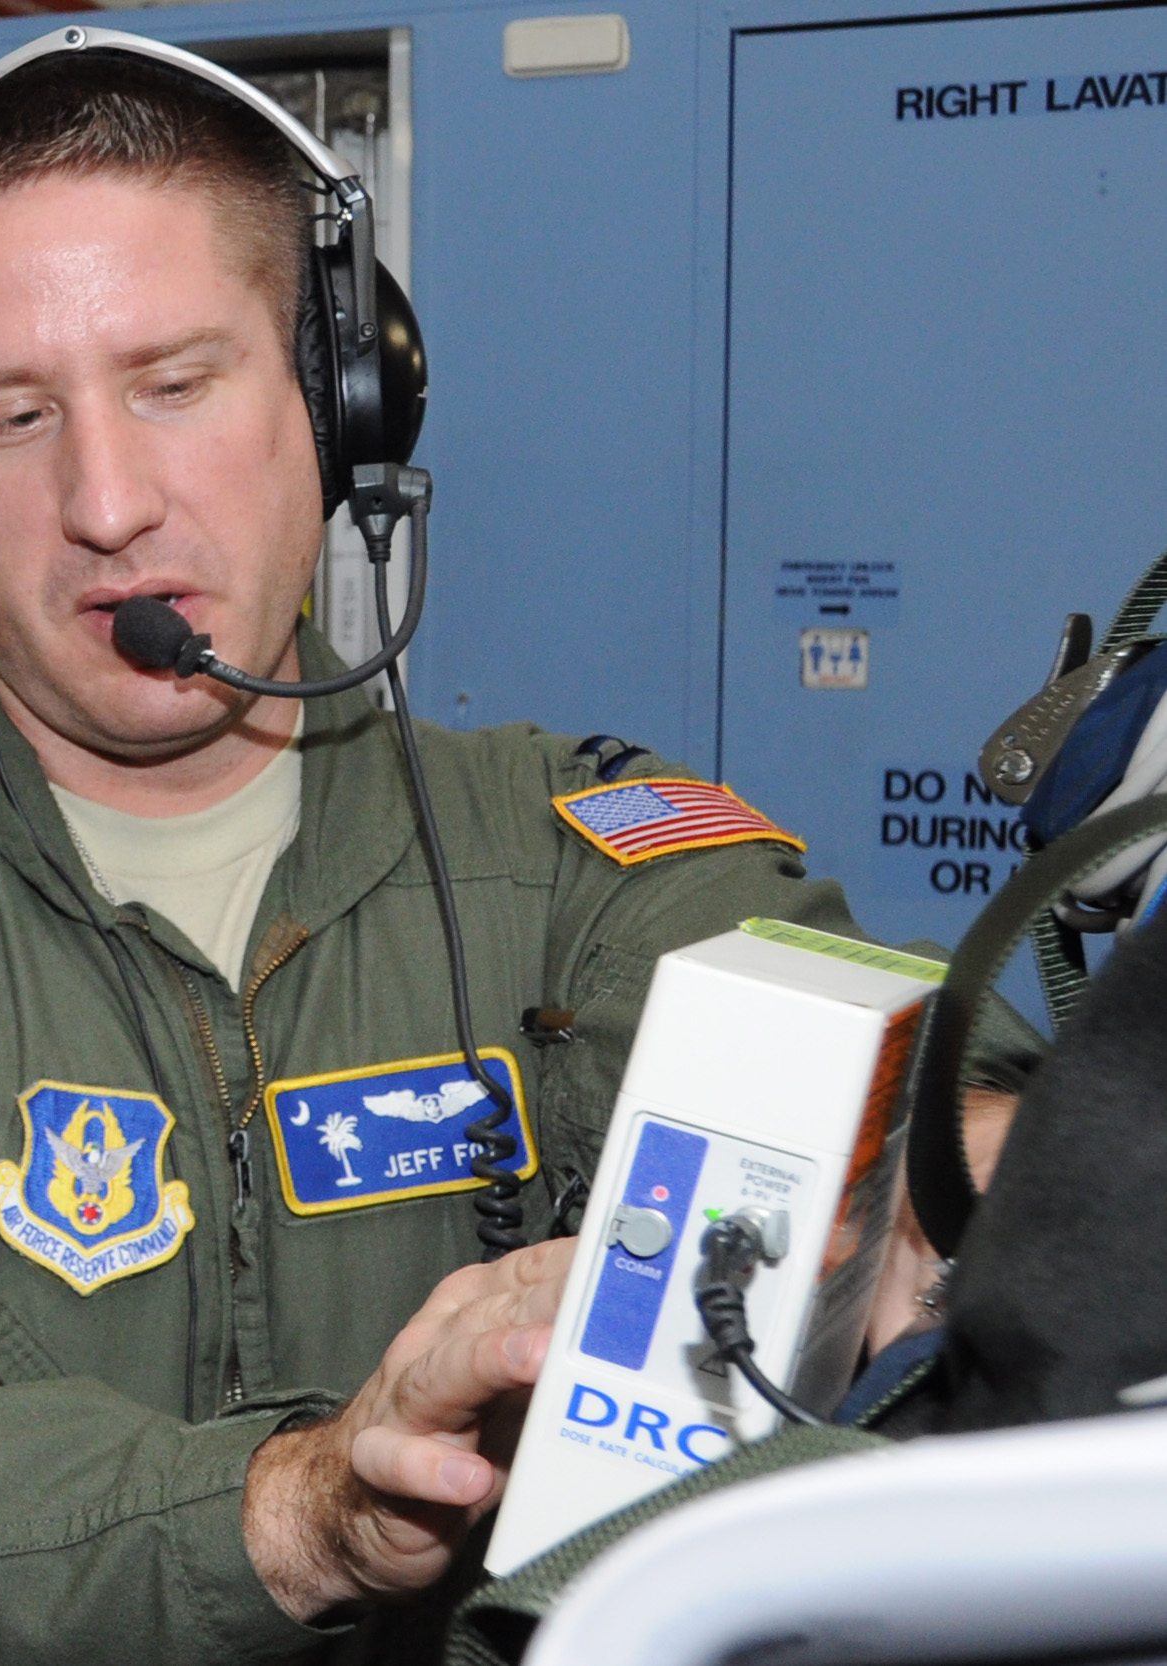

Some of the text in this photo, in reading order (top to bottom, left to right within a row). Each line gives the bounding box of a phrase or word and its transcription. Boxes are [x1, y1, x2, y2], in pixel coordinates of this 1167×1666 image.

[896, 72, 1167, 120] RIGHT LAVAT
[884, 769, 1020, 806] DO N
[930, 860, 991, 894] OR
[385, 1147, 444, 1178] JEFF
[739, 1157, 802, 1186] EXTERNAL
[745, 1173, 791, 1194] POWER
[2, 1205, 178, 1283] AIR FORCE RESERVE COMMAND
[614, 1257, 663, 1281] COMM
[566, 1383, 729, 1467] DRC
[560, 1427, 593, 1446] DOSE
[598, 1440, 629, 1458] RATE
